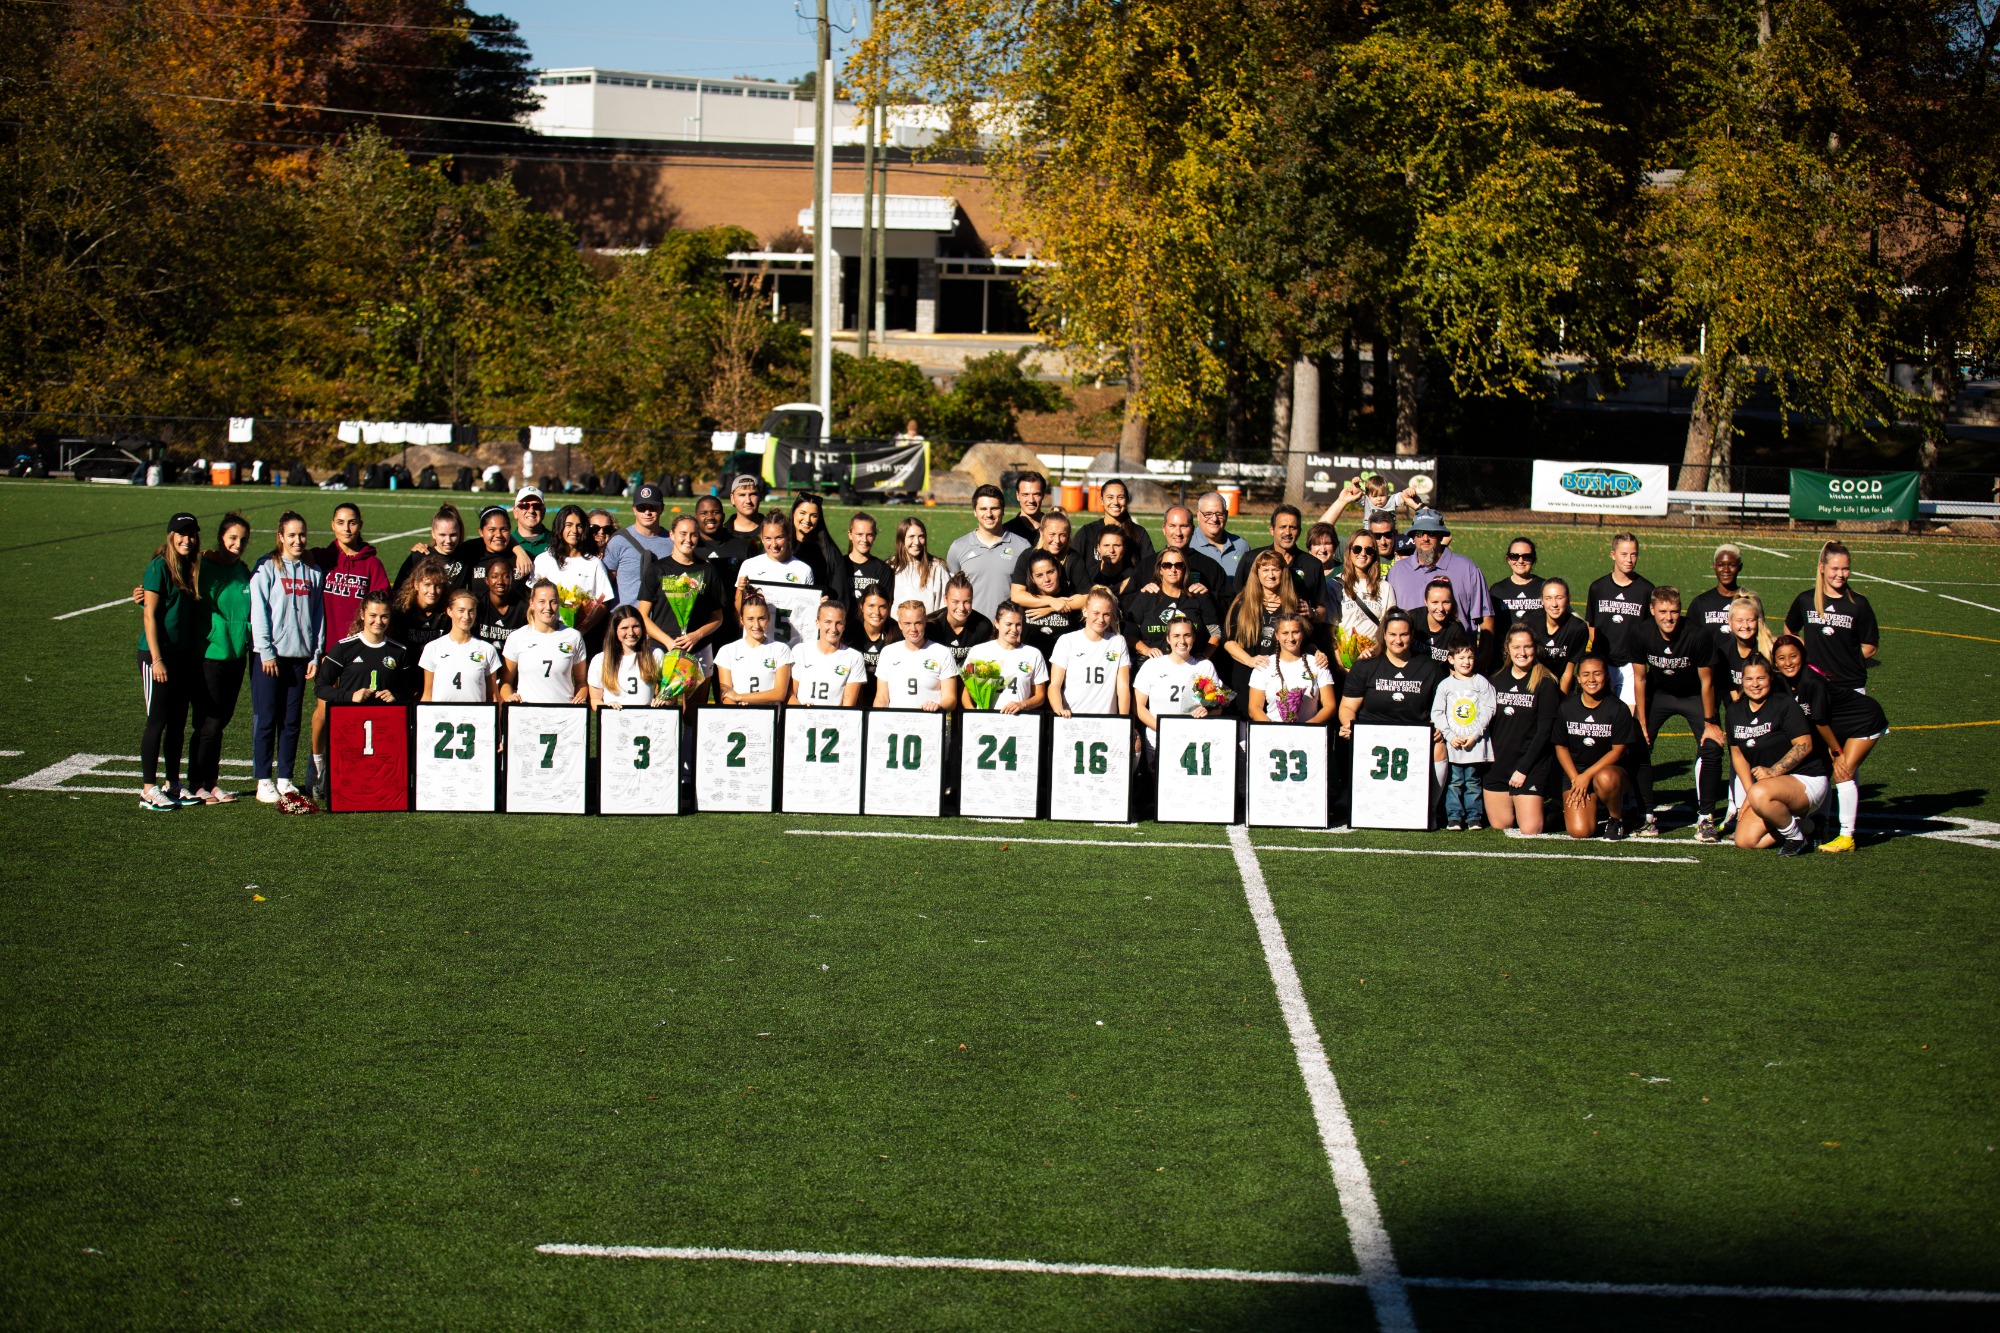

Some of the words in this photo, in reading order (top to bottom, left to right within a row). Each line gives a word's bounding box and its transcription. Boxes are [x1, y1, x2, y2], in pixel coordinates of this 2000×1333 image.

[1307, 455, 1332, 467] Live
[1334, 456, 1360, 468] LIFE
[1361, 458, 1375, 469] to
[1828, 479, 1883, 493] GOOD
[1818, 505, 1832, 514] Play
[1833, 505, 1842, 513] for
[1843, 505, 1855, 513] Life
[1881, 506, 1894, 514] Life
[1609, 600, 1642, 611] UNIVERSITY
[1621, 608, 1641, 616] SOCCER
[1705, 610, 1717, 618] LIFE
[774, 607, 793, 642] 5
[1820, 612, 1853, 623] NIVERSITY
[1148, 625, 1161, 633] LIFE
[543, 660, 553, 678] 7
[1085, 666, 1105, 685] 16
[369, 669, 378, 691] 1
[453, 671, 462, 690] 4
[627, 676, 638, 695] 3
[749, 676, 760, 693] 2
[907, 678, 918, 696] 9
[1388, 679, 1423, 688] UNIVERSITY
[810, 681, 829, 700] 12
[1504, 692, 1535, 702] UNIVERSITY
[1513, 700, 1533, 708] SOCCER
[1566, 720, 1579, 729] LIFE
[1579, 722, 1613, 731] UNIVERSITY
[1567, 728, 1591, 737] WOMEN'S
[1591, 730, 1612, 738] SOCCER
[362, 720, 374, 755] 1
[434, 722, 476, 760] 23
[805, 727, 840, 763] 12
[539, 733, 558, 769] 7
[633, 735, 651, 770] 3
[726, 731, 747, 768] 2
[886, 733, 922, 770] 10
[977, 734, 1018, 771] 24
[1074, 740, 1108, 775] 16
[1179, 742, 1212, 776] 41
[1269, 749, 1308, 782] 33
[1370, 745, 1409, 782] 38
